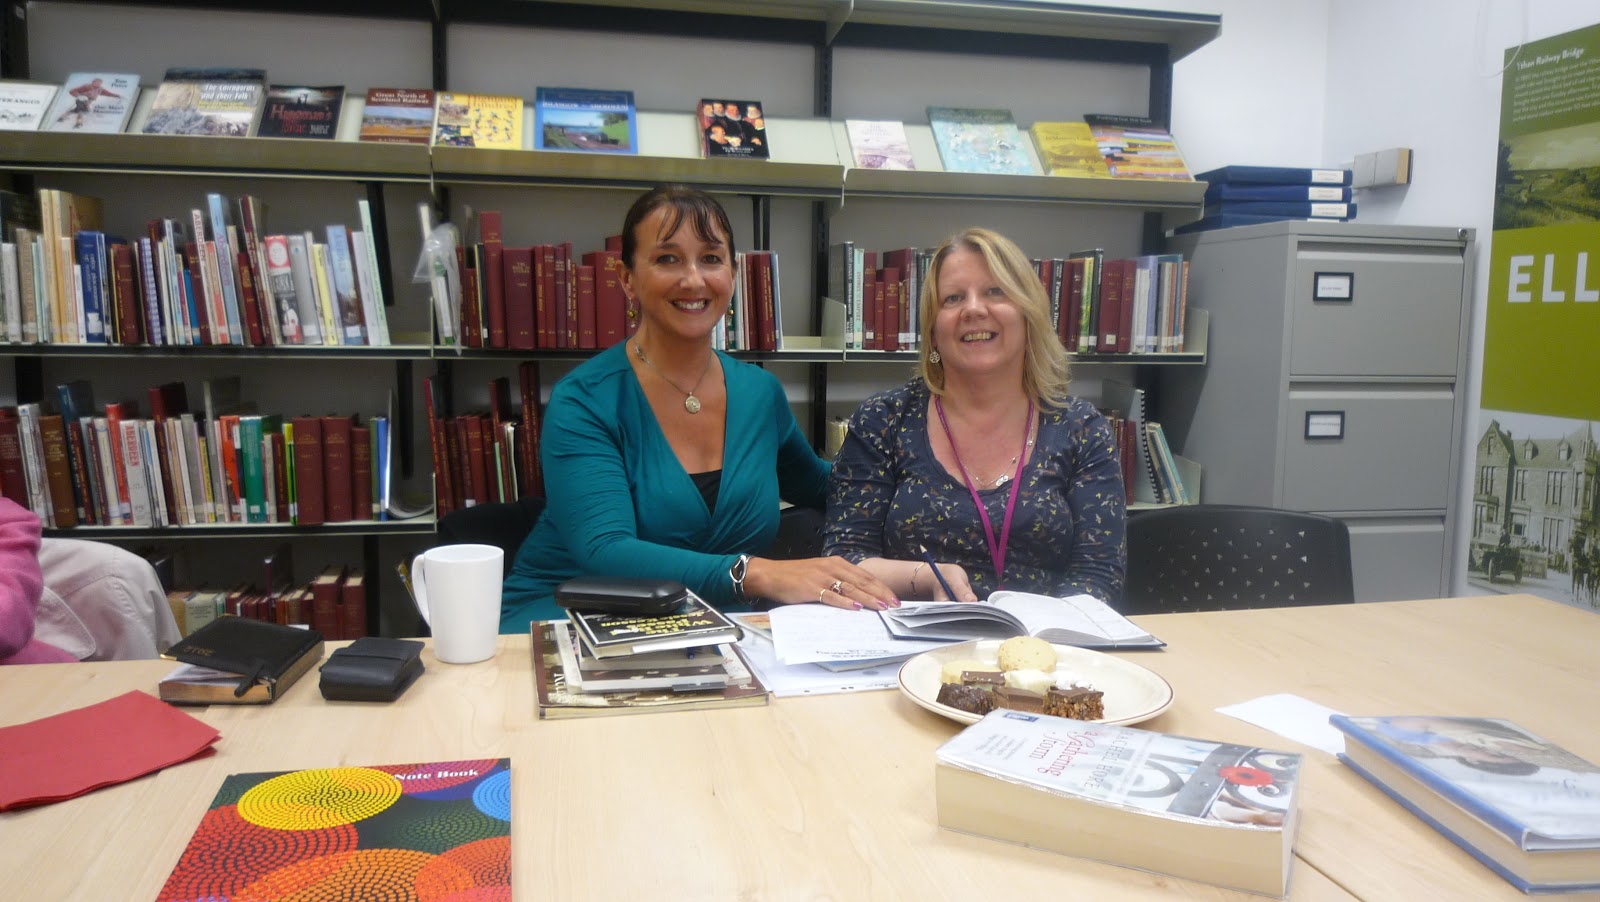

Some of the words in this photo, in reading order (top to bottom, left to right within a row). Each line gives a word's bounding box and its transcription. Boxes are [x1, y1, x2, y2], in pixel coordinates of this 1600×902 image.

[1536, 54, 1561, 65] Railway
[1562, 48, 1584, 59] Bridge
[193, 213, 206, 262] ABERDEEN
[216, 233, 230, 286] Aberdeen
[1052, 312, 1060, 331] Diary
[125, 425, 139, 466] ABERDEEN
[1037, 731, 1096, 776] Gathering
[393, 771, 431, 781] Note
[437, 769, 478, 779] Book
[1084, 763, 1113, 791] HORE
